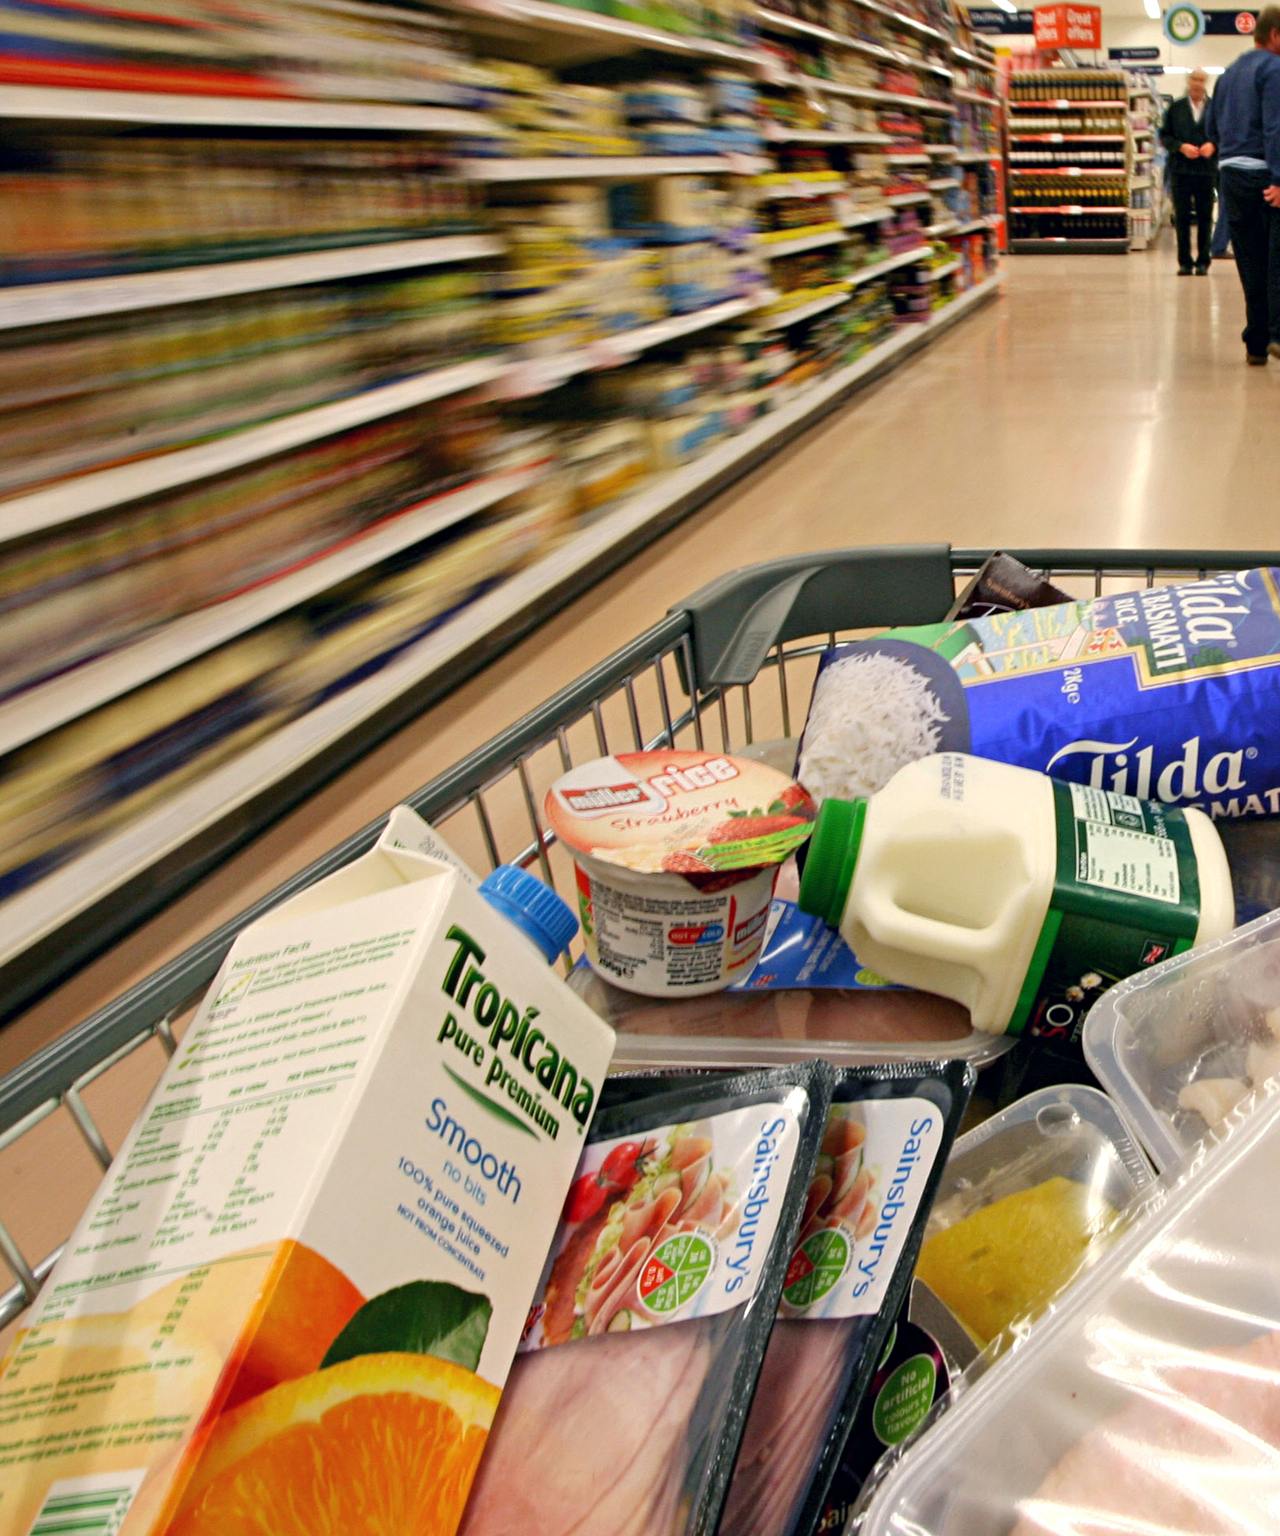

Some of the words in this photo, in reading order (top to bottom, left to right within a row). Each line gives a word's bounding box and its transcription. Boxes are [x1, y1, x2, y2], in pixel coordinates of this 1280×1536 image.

[1143, 594, 1188, 670] BASMATI
[650, 757, 740, 799] rice
[1046, 736, 1247, 804] Tilda
[610, 797, 740, 832] Strawberry
[442, 923, 595, 1127] Tropicana
[437, 1011, 485, 1068] pure
[485, 1054, 560, 1141] premium
[425, 1097, 522, 1204] Smooth
[443, 1160, 462, 1184] no
[463, 1174, 488, 1207] bits
[397, 1157, 434, 1194] 100%
[434, 1189, 460, 1216] pure
[460, 1210, 510, 1260] squeezed
[397, 1203, 415, 1224] NOT
[416, 1196, 456, 1234] orange
[455, 1226, 481, 1257] juice
[724, 1117, 786, 1294] Sainsbury's
[851, 1117, 932, 1298] Sainsbury's
[883, 1371, 931, 1412] artificial
[901, 1370, 917, 1387] No
